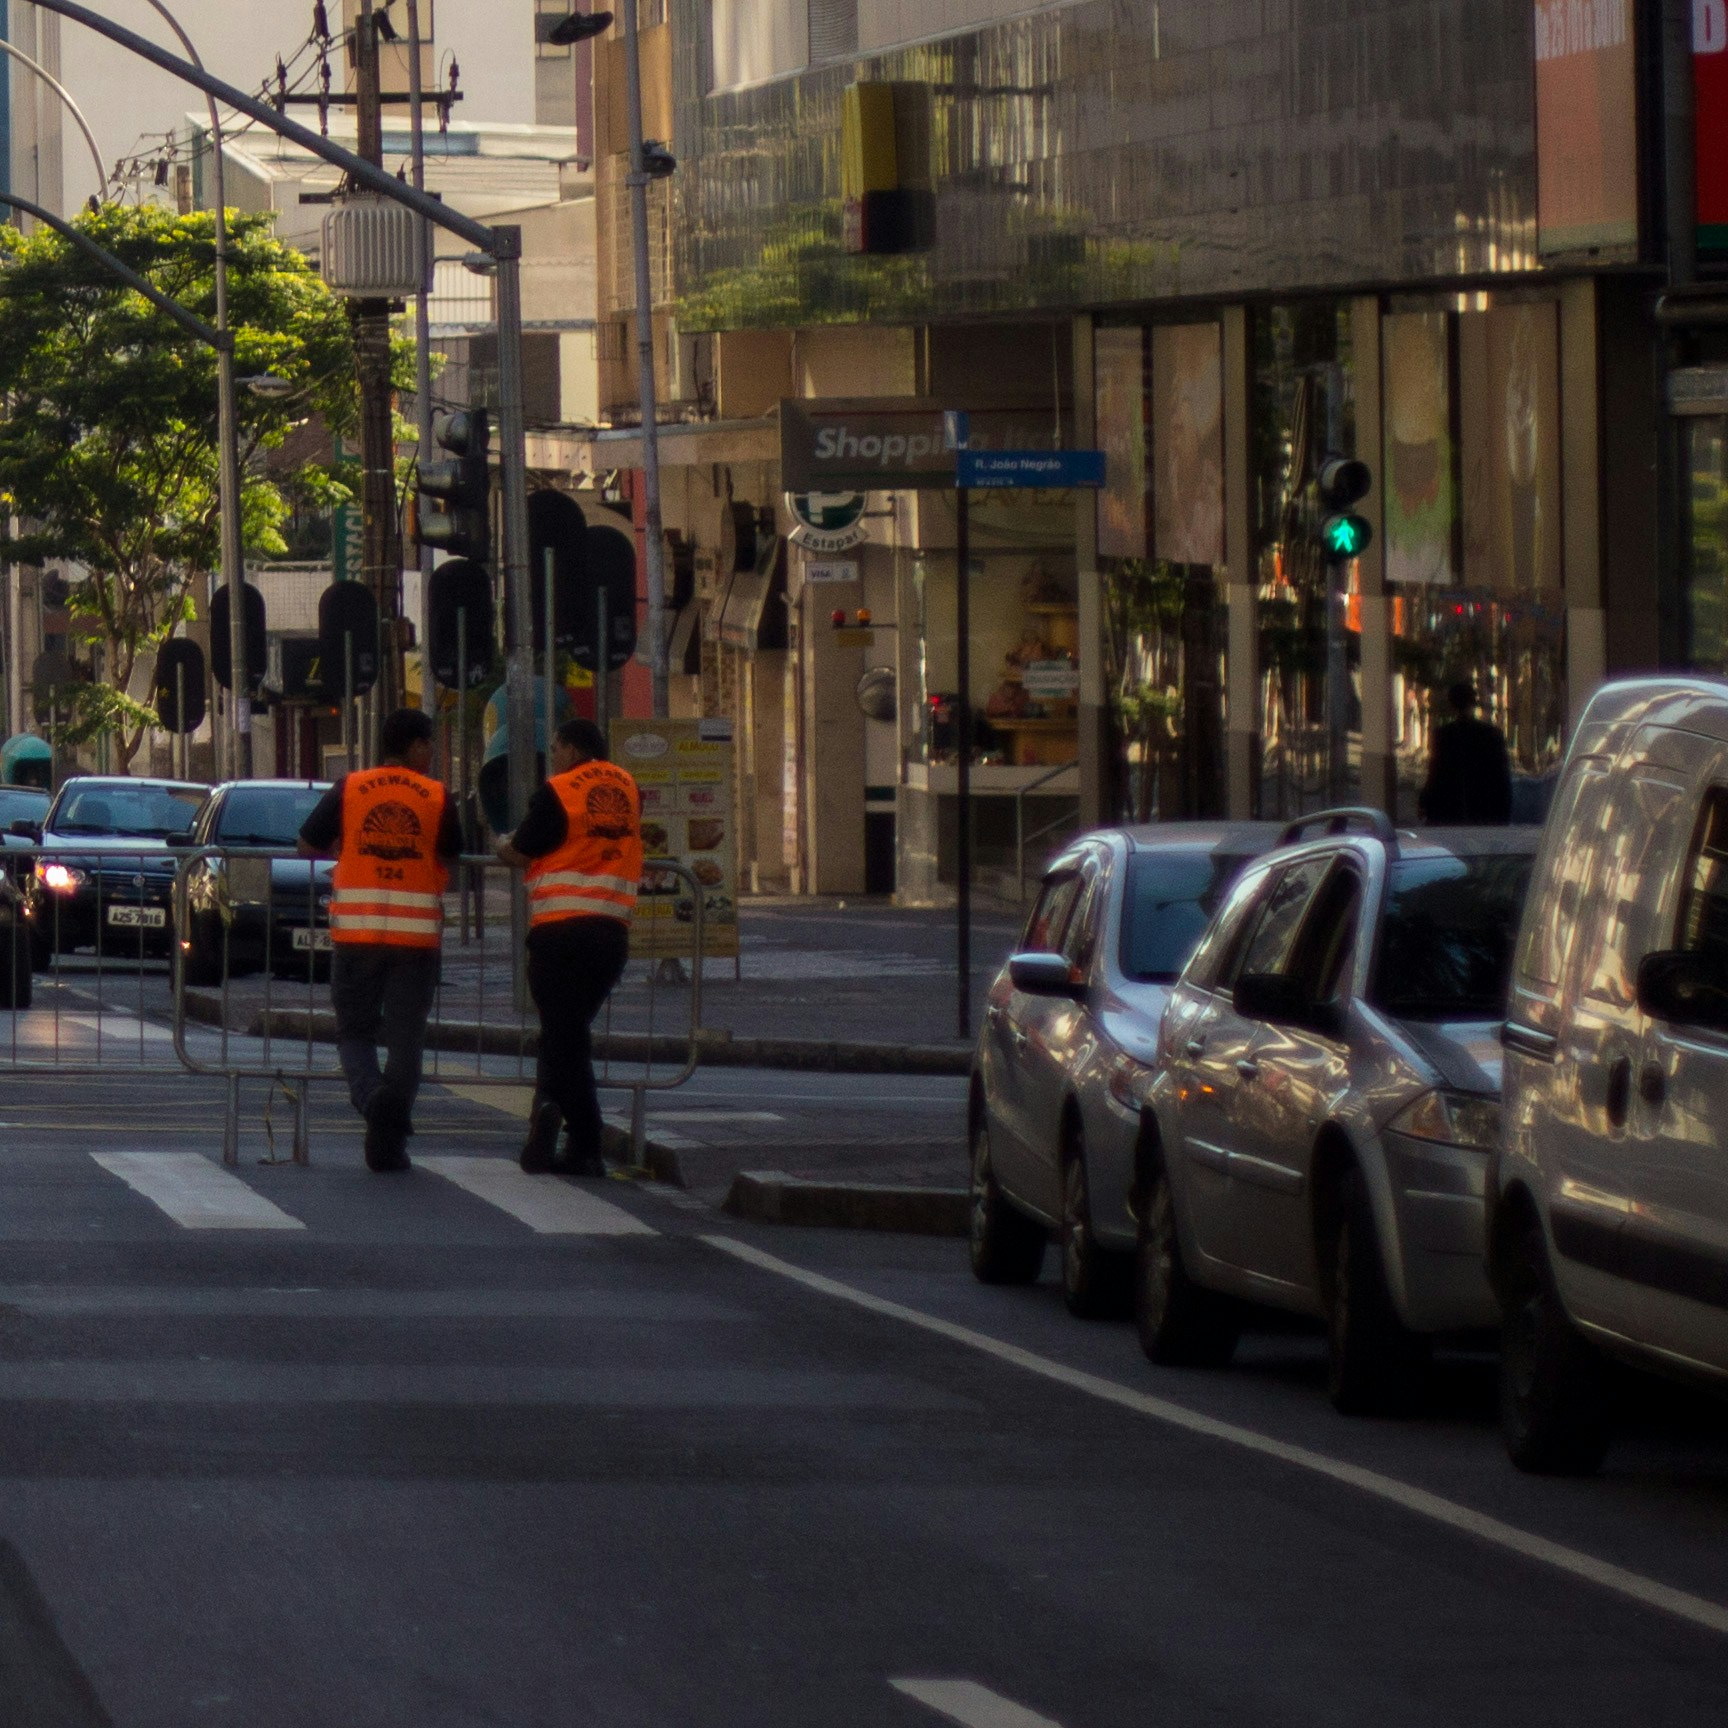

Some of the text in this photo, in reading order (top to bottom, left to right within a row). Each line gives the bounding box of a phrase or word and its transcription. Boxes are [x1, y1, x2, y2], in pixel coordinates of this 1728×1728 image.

[975, 458, 1062, 473] R. João Negrão
[802, 531, 859, 550] Estapar
[359, 775, 430, 799] STEWARD
[376, 867, 404, 881] 124
